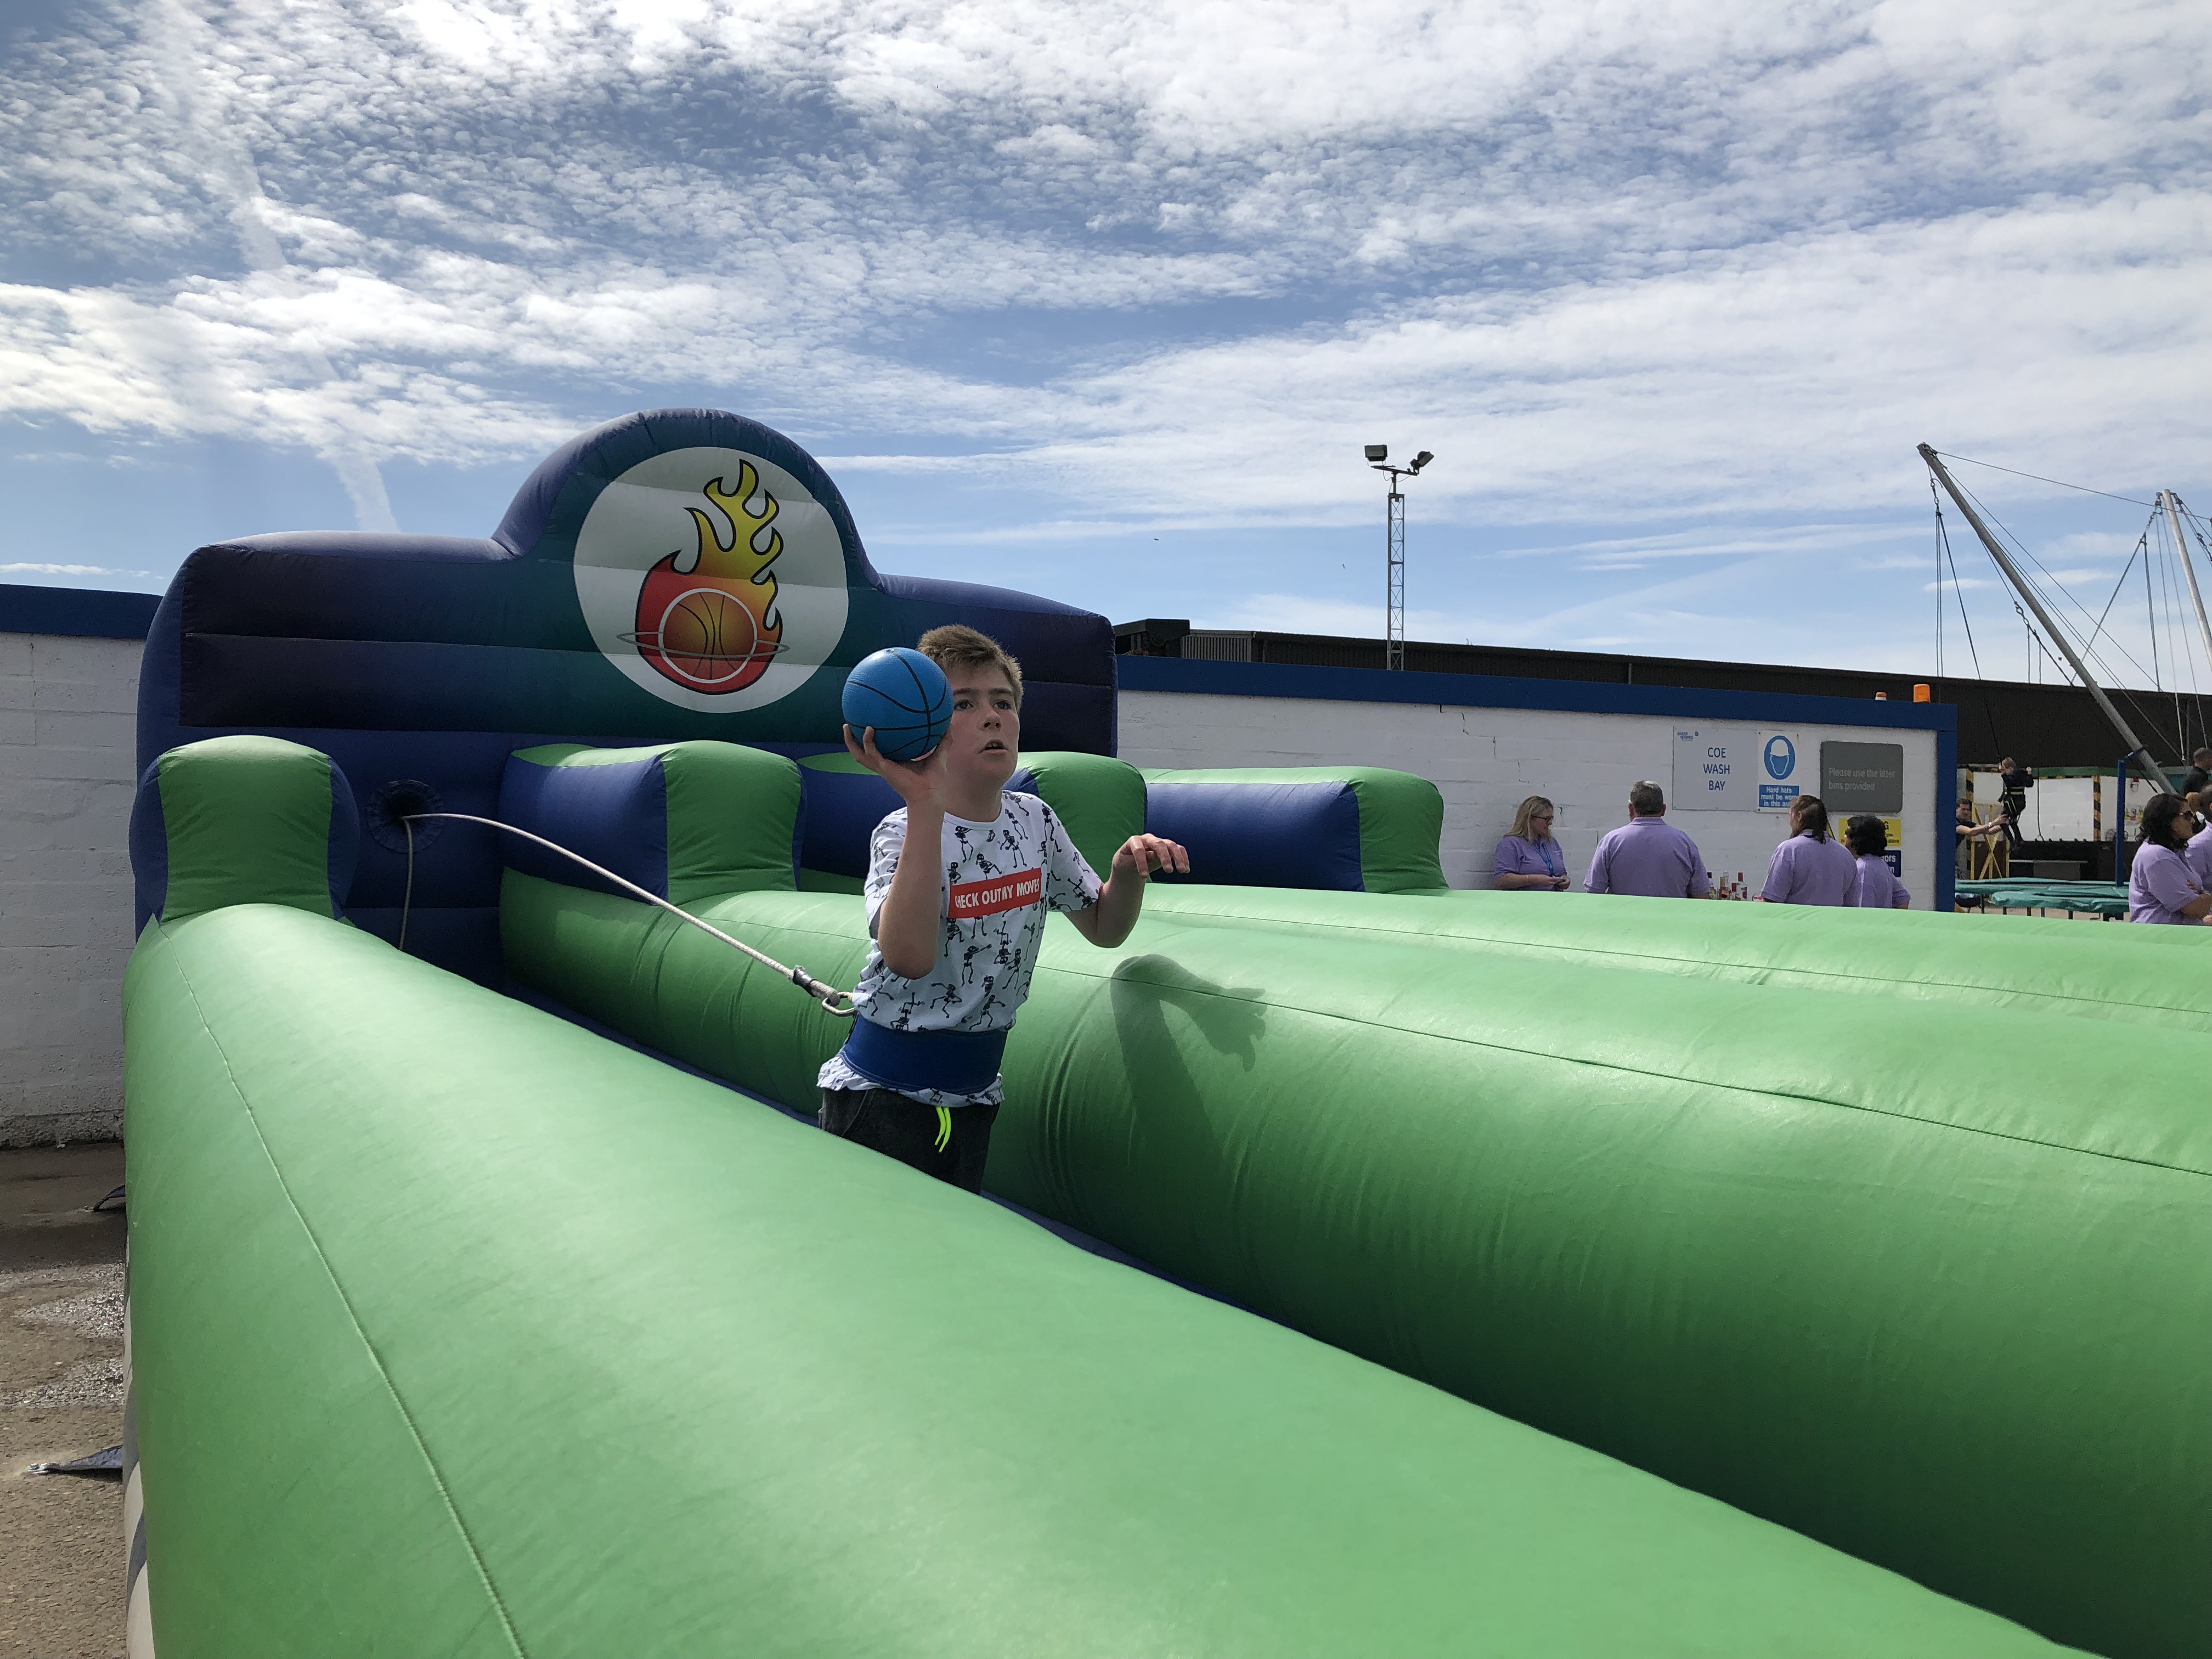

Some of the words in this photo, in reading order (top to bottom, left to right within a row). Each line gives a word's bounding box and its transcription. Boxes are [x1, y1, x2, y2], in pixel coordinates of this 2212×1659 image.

[1707, 747, 1726, 758] COE
[1703, 763, 1730, 775] WASH
[1829, 768, 1852, 777] Please
[1867, 769, 1878, 777] the
[1708, 780, 1725, 791] BAY
[1829, 780, 1843, 789] bins
[1844, 782, 1875, 792] provided
[981, 888, 1002, 905] OUT
[1016, 878, 1040, 897] MOVES
